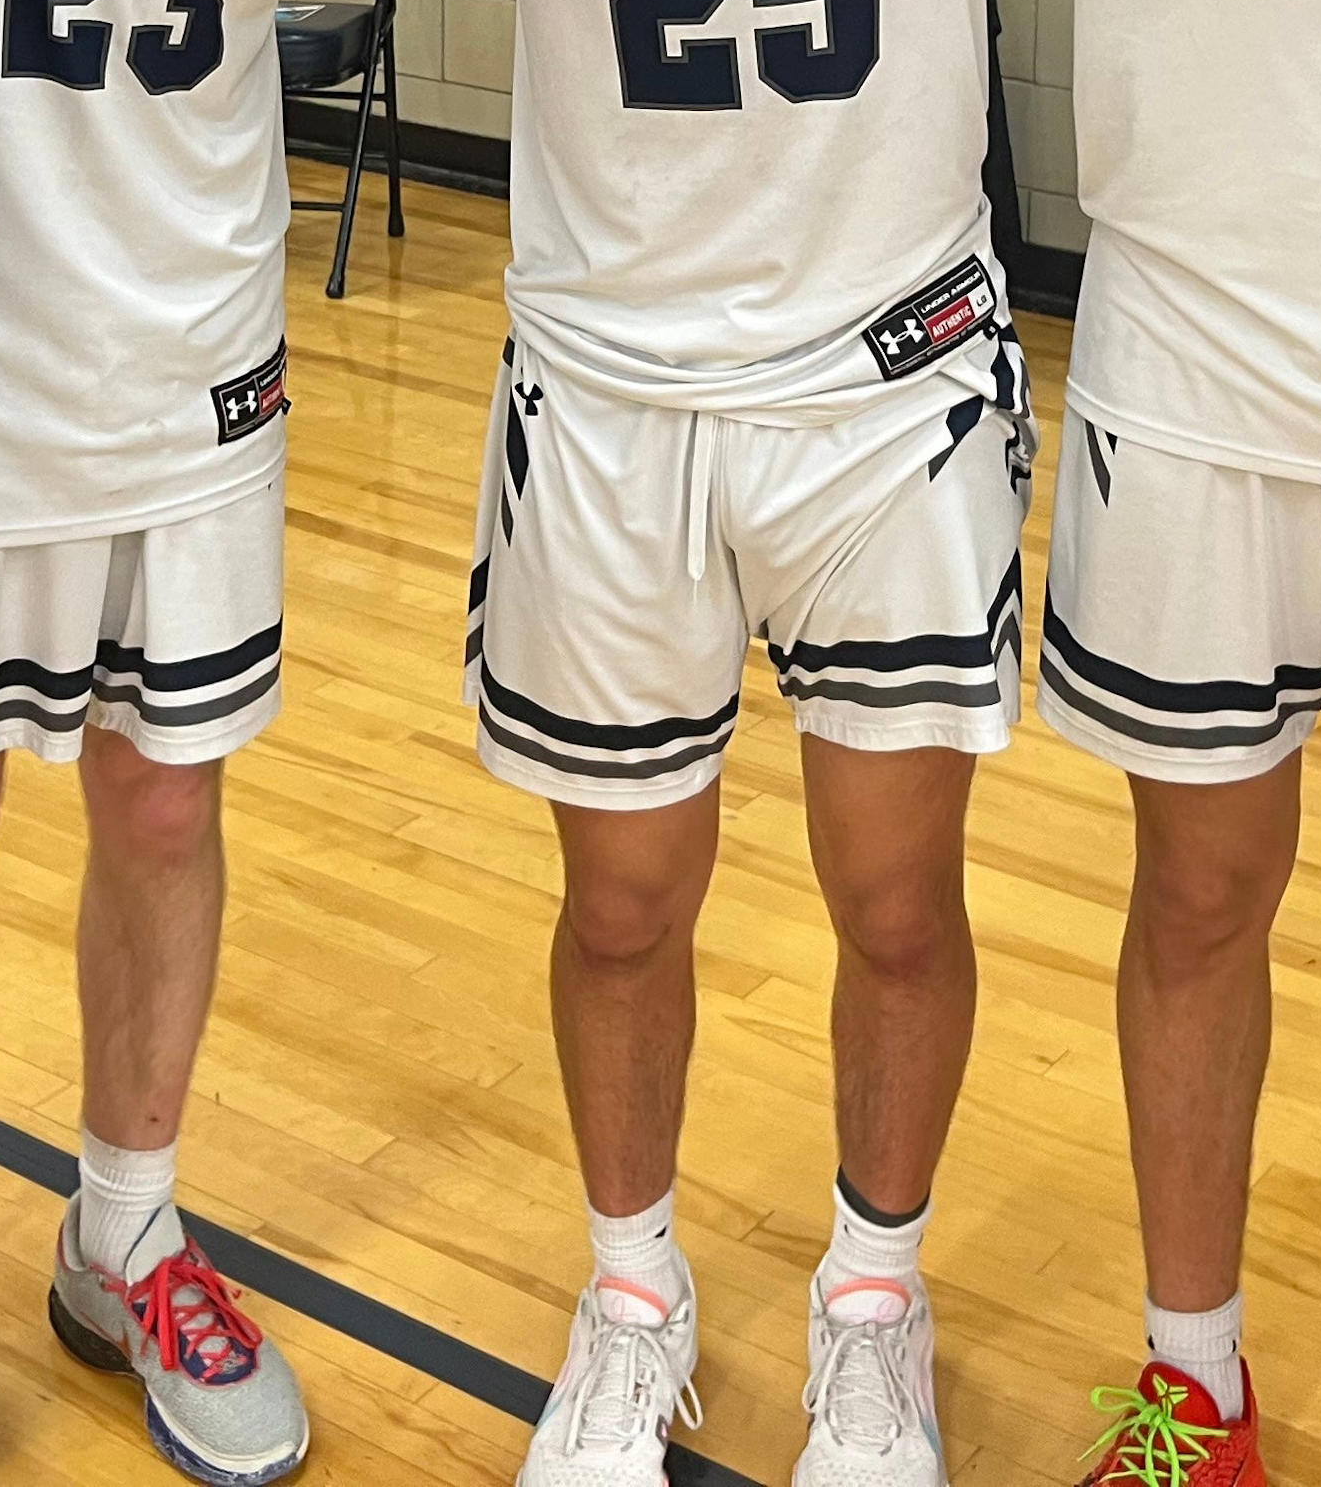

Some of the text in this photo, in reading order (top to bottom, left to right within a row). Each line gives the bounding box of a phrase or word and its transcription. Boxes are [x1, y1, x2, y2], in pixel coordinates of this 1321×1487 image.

[920, 270, 982, 314] UNDER ARMOUR
[931, 304, 973, 338] AUTHENTIC
